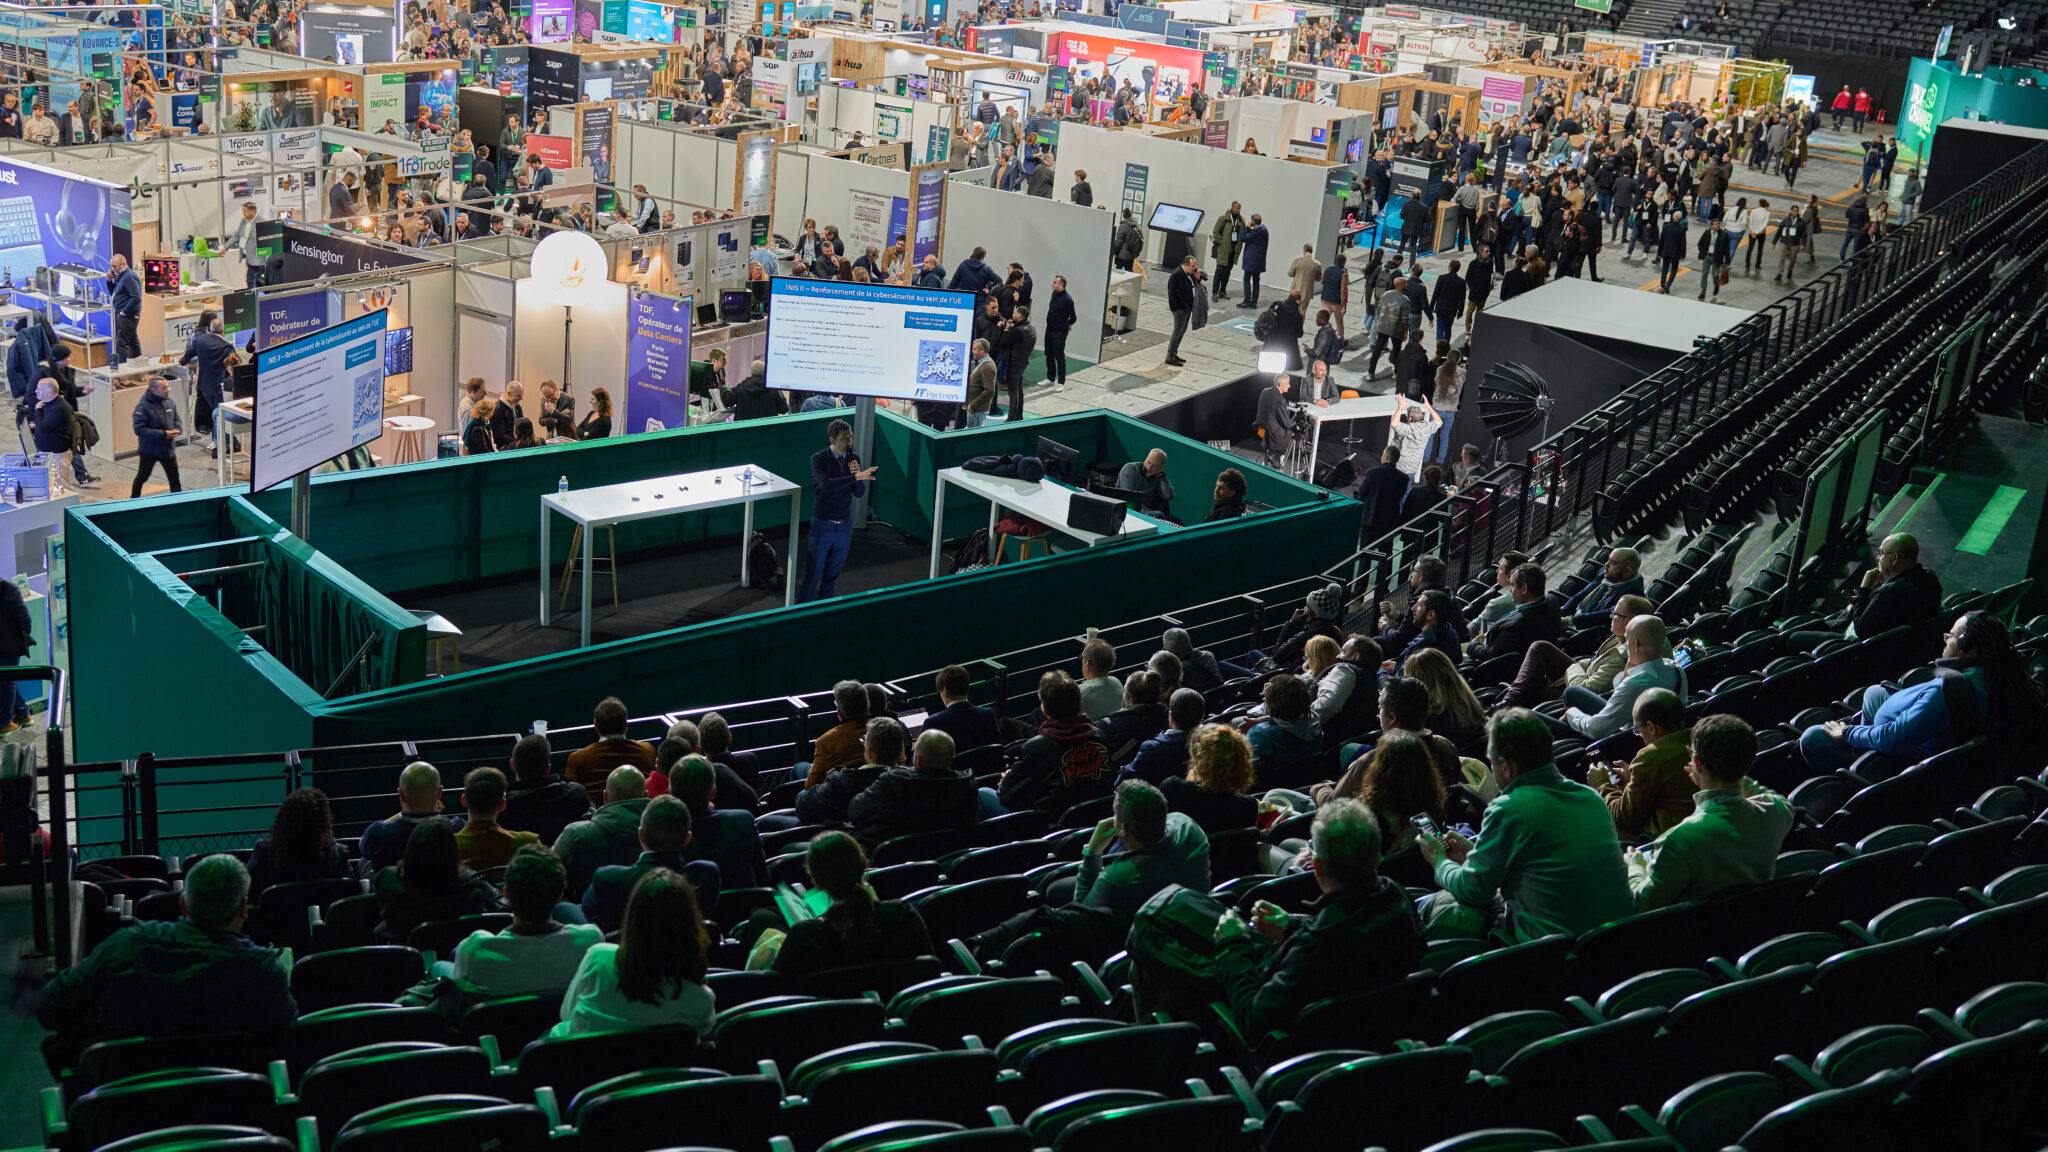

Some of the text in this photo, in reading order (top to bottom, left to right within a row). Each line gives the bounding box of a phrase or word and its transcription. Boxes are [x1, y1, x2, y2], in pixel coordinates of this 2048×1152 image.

[82, 37, 120, 48] ADVANCE-S
[370, 98, 398, 108] IMPACT
[867, 153, 897, 166] Partners
[0, 169, 17, 184] ust
[291, 240, 343, 265] Kensington
[358, 258, 371, 272] Le
[811, 286, 855, 296] Renforcement
[873, 291, 915, 301] cybersécurité
[269, 317, 321, 334] Opérateur de
[638, 315, 683, 334] Opérateur de
[638, 326, 682, 345] Data Centers
[914, 388, 959, 400] IT Partners
